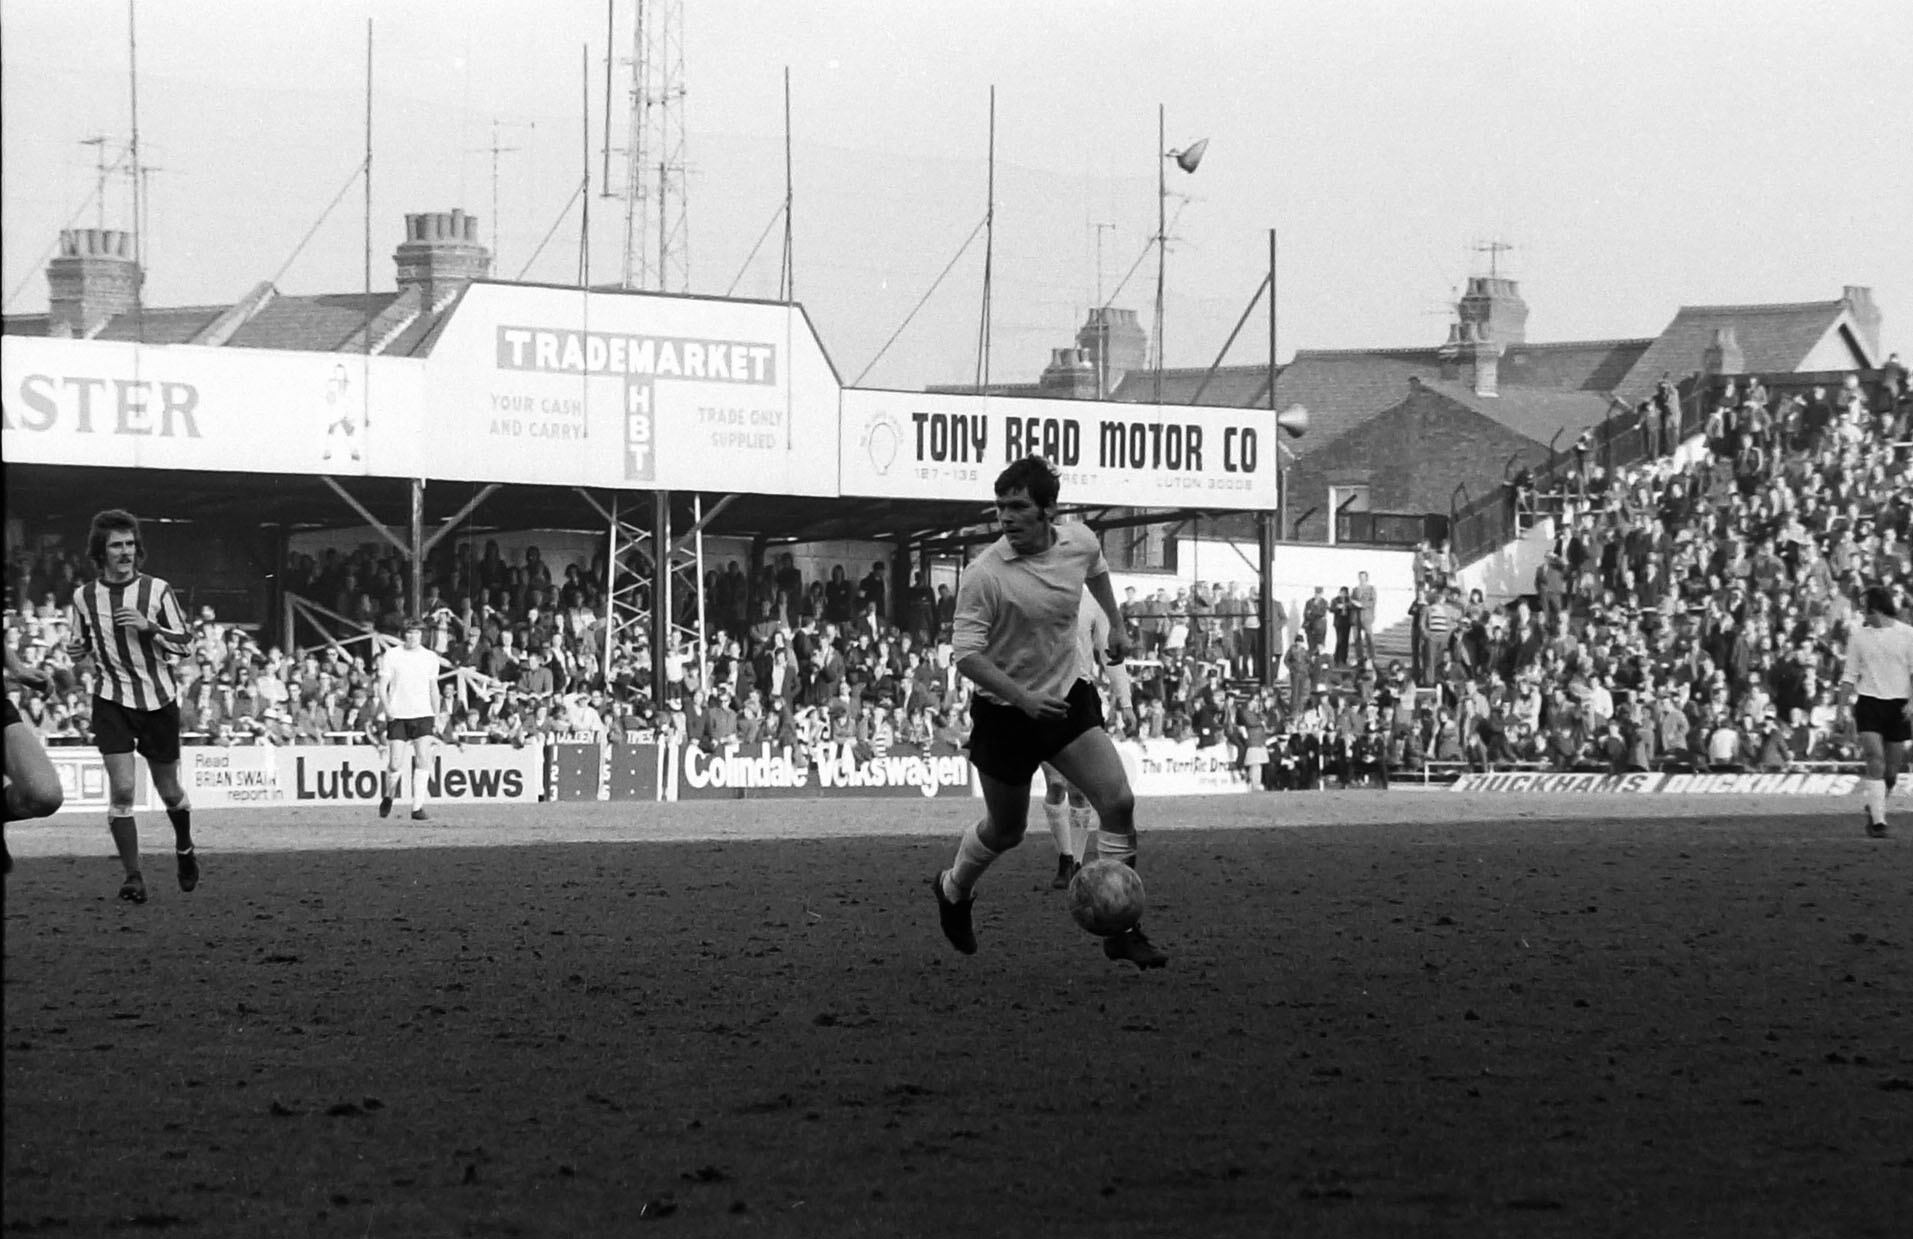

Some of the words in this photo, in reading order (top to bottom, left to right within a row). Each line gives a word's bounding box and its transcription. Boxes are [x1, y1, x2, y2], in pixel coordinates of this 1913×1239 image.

[503, 328, 771, 381] TRADEMARKET
[490, 392, 534, 412] YOUR
[541, 399, 581, 416] CASH
[697, 407, 745, 425] TRADE
[751, 409, 782, 426] ONLY
[489, 419, 522, 437] AND
[528, 422, 582, 440] CARRY
[711, 432, 776, 449] SUPPLIED
[912, 412, 987, 463] TONY
[1005, 416, 1080, 467] READ
[1100, 420, 1202, 471] MOTOR
[1223, 427, 1257, 473] CO
[196, 753, 229, 767] Read
[685, 740, 807, 788] Colindale
[1459, 774, 1641, 792] DUCKHAMS
[1664, 774, 1860, 795] DUCKHAMS
